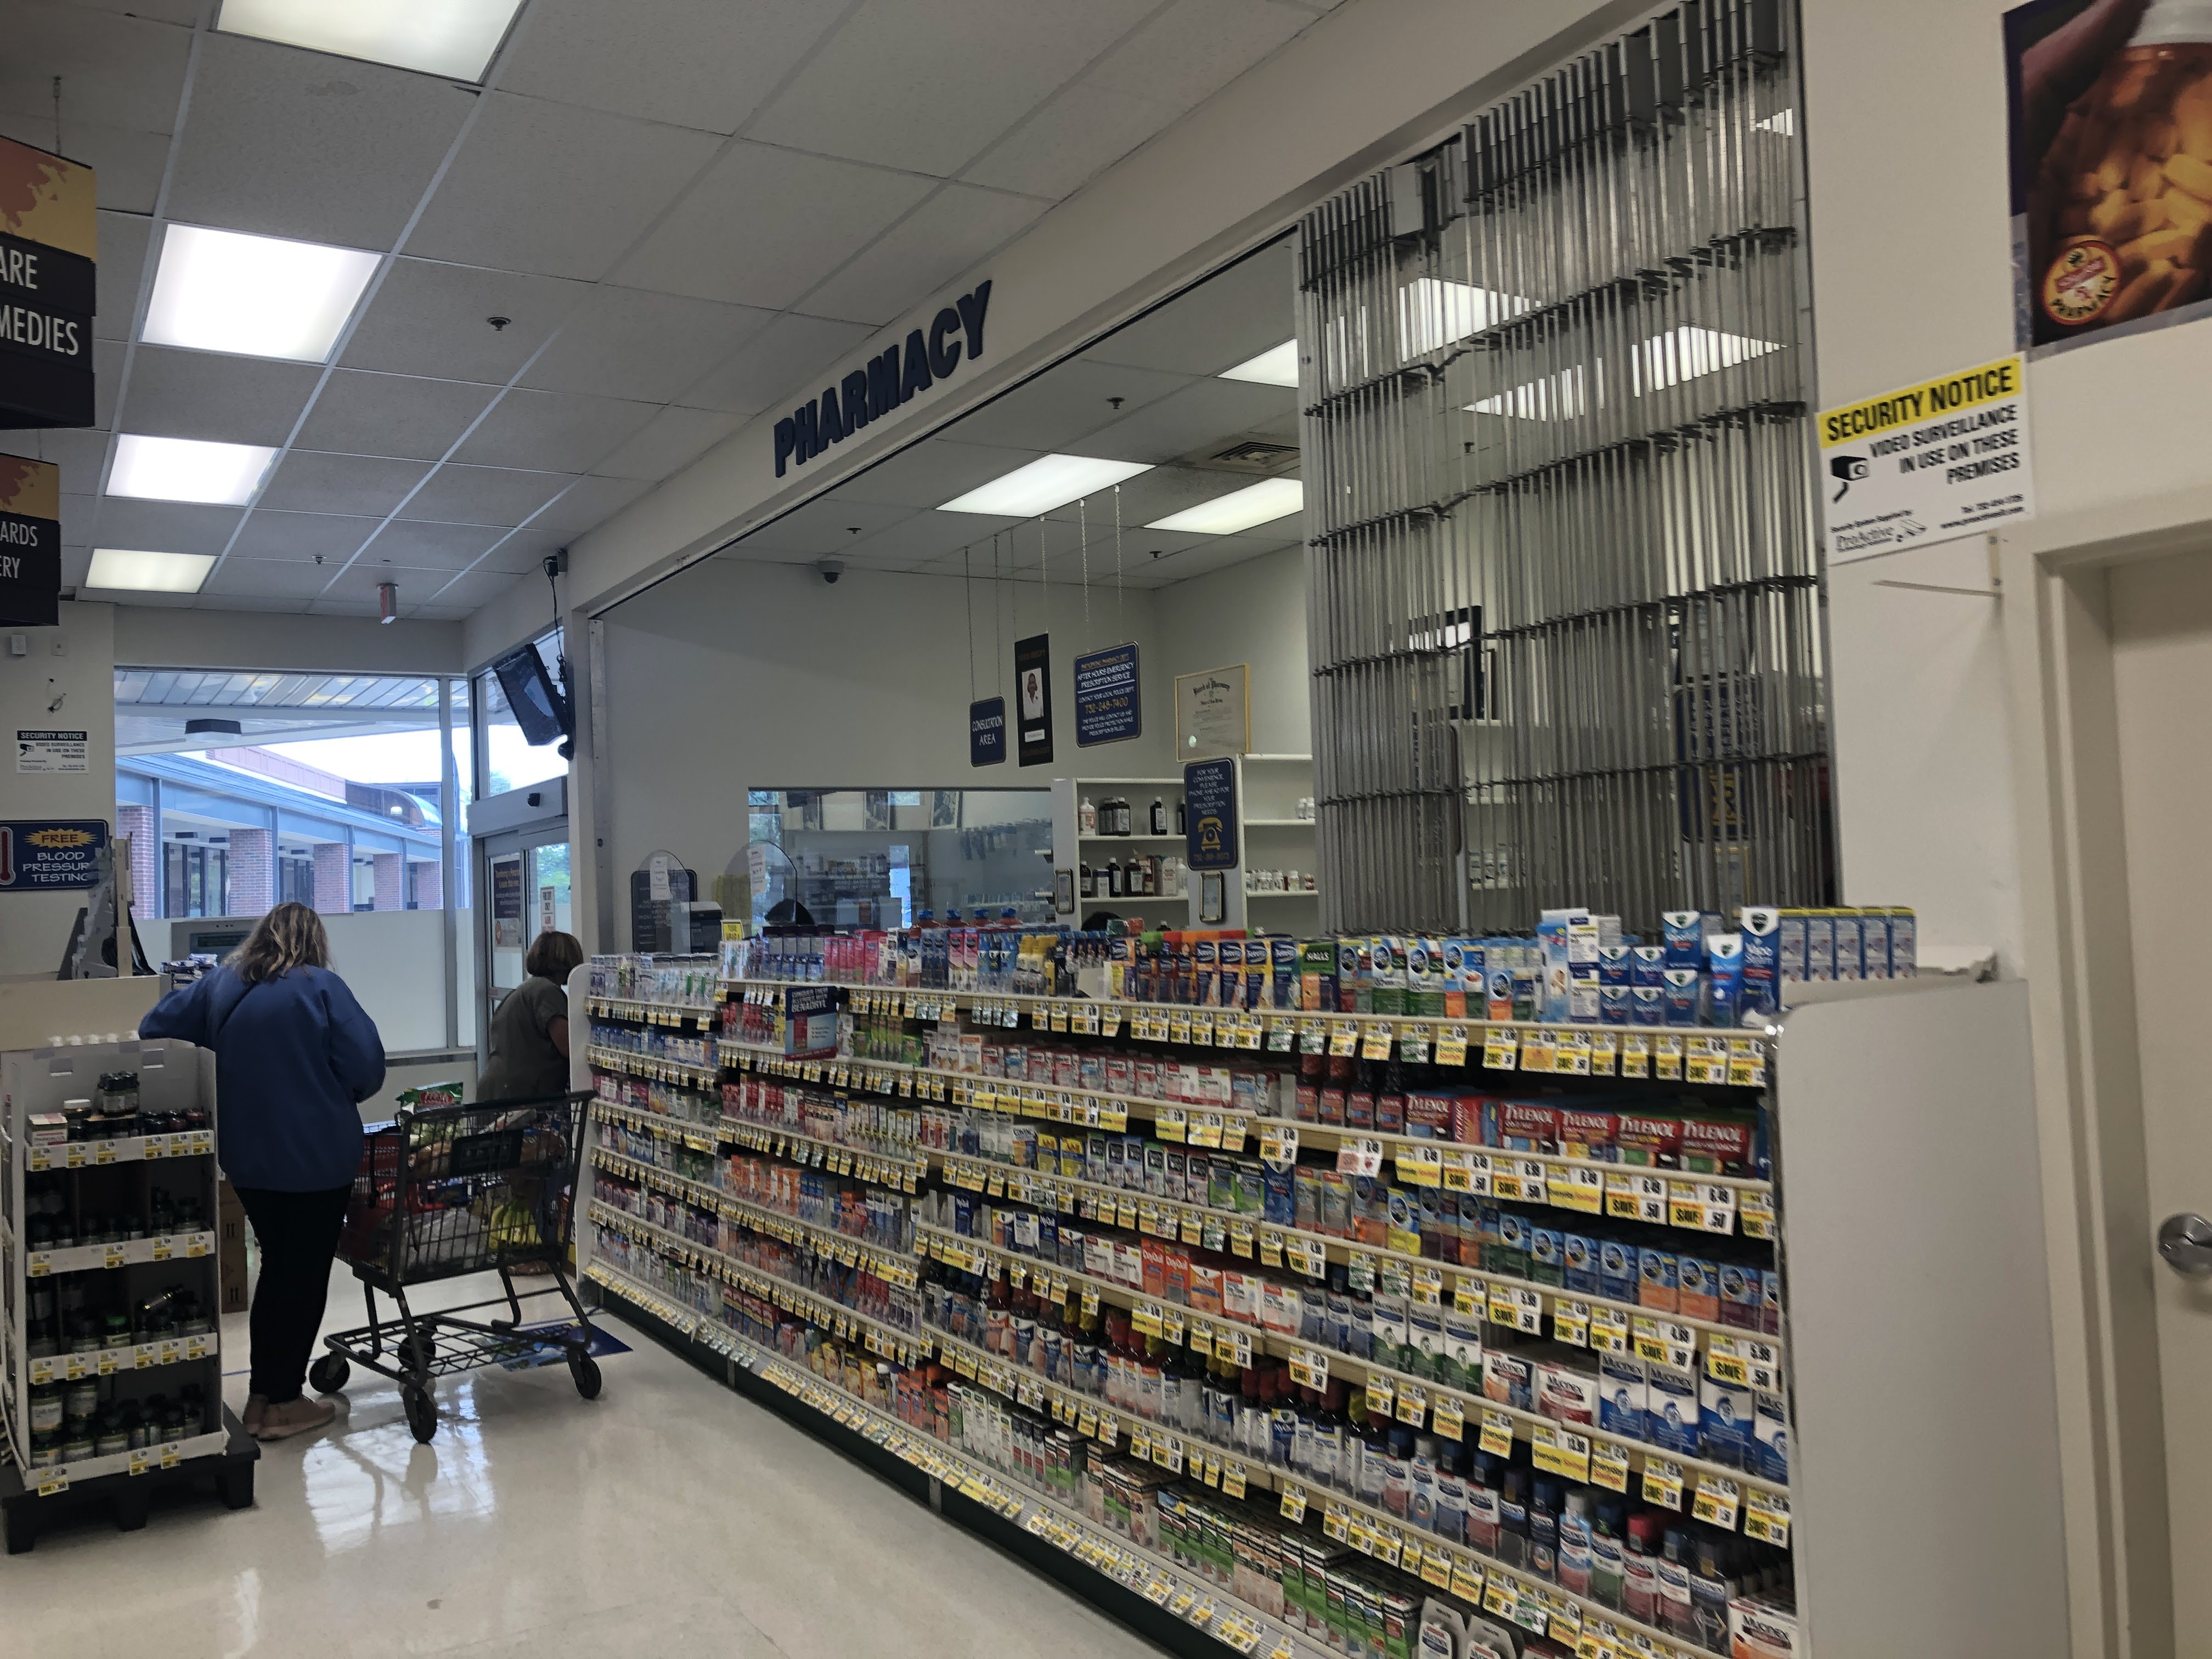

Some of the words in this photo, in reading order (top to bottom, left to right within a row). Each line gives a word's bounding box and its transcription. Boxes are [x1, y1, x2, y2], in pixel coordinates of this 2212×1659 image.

[774, 280, 992, 478] PHARMACY
[1827, 391, 1925, 441] SECURITY
[1928, 366, 2013, 412] NOTICE
[1869, 435, 1910, 458] VIDEO
[1913, 404, 2018, 446] SURVEILLANCE
[1899, 456, 1915, 473] IN
[1917, 448, 1945, 469] USE
[1948, 442, 1970, 460] ON
[1973, 429, 2019, 454] THESE
[1947, 453, 2020, 484] PREMISES
[0, 521, 38, 546] ARDS
[972, 715, 1003, 732] CONSULTATION
[979, 732, 996, 746] AREA
[42, 834, 78, 843] FREE
[37, 852, 85, 861] BLOOD
[22, 862, 89, 872] PRESSUR
[1306, 951, 1329, 961] HALLS
[1406, 1093, 1449, 1113] TYLENOL
[1504, 1103, 1554, 1125] TYLENOL
[1561, 1110, 1610, 1130] TYLENOL
[1617, 1115, 1675, 1138] TYLENOL
[1681, 1119, 1742, 1143] TYLENOL
[1612, 1199, 1634, 1215] SAVE
[1676, 1208, 1700, 1224] SAVE
[1640, 1343, 1663, 1361] SAVE
[1492, 1357, 1527, 1376] Mucinex
[1602, 1353, 1644, 1375] Mucinex
[1716, 1361, 1742, 1380] SAVE
[1548, 1374, 1584, 1396] Mucinex
[1650, 1368, 1694, 1389] Mucinex
[1743, 1614, 1789, 1641] Mucinex
